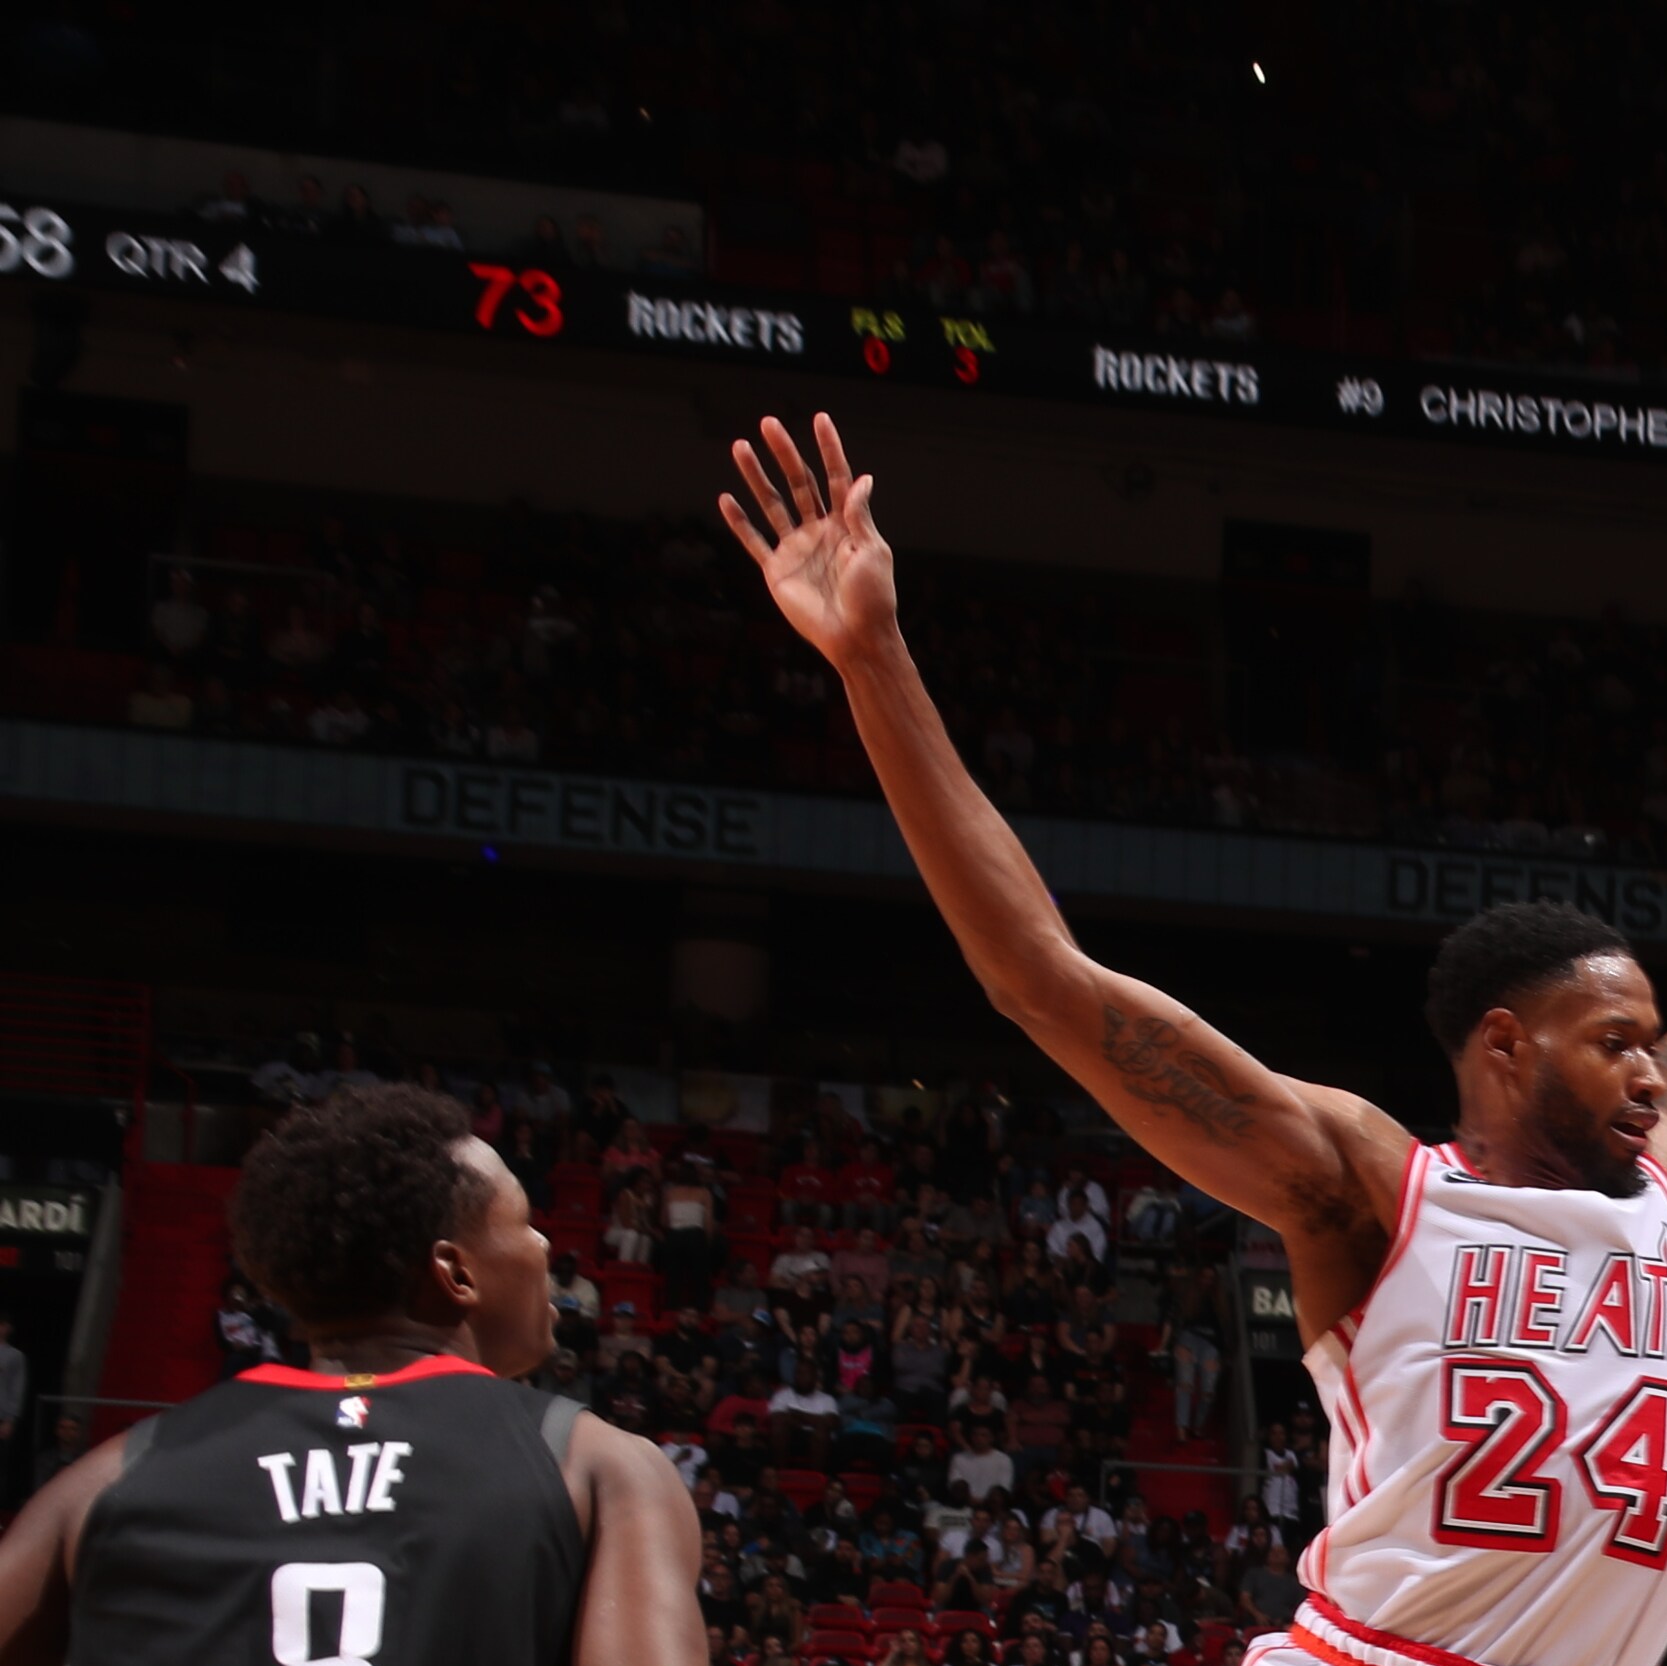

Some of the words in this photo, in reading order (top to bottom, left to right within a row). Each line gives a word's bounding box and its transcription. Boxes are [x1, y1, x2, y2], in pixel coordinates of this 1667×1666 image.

[105, 231, 210, 286] QTR
[218, 241, 259, 294] 4
[466, 260, 564, 338] 73
[626, 289, 806, 354] ROCKETS
[1093, 343, 1261, 405] ROCKETS
[403, 767, 760, 857] DEFENSE
[257, 1441, 414, 1523] TATE
